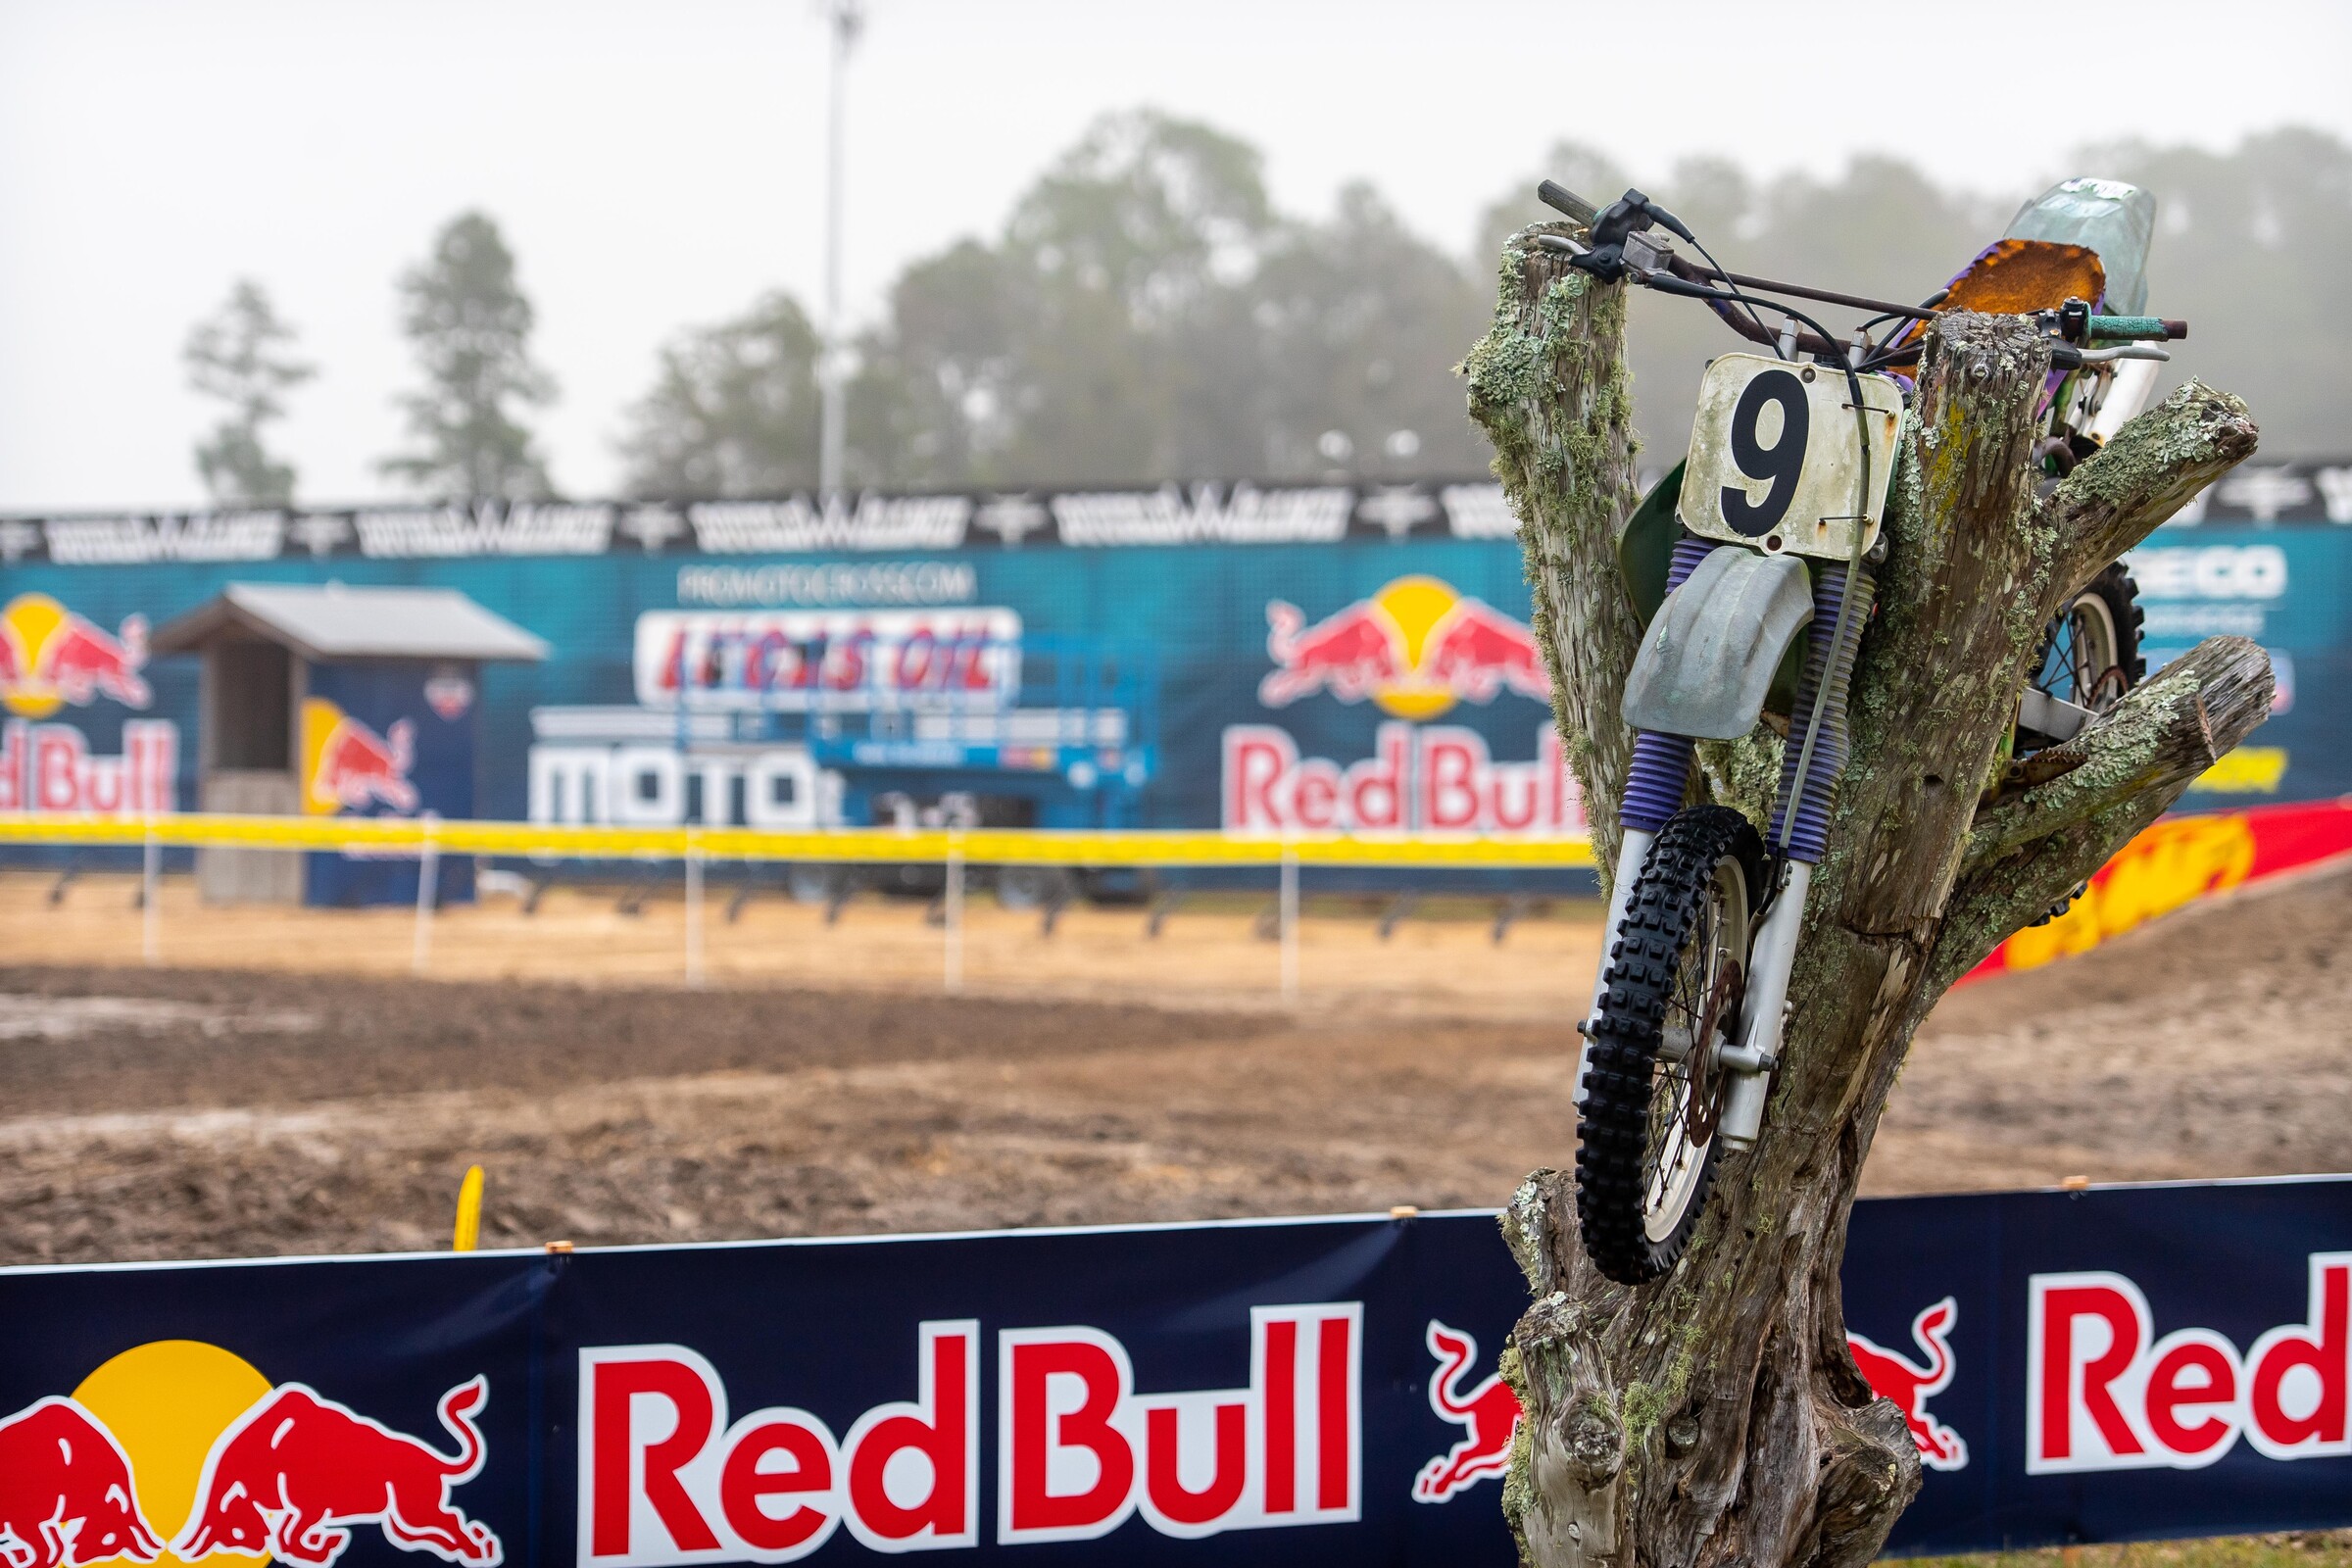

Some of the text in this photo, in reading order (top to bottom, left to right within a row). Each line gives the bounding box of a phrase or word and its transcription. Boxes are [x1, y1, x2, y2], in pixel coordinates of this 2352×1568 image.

[1721, 369, 1810, 538] 9
[37, 721, 177, 811] Bull
[1227, 725, 1586, 833] Red Bul
[584, 1307, 1358, 1564] Red Bull
[2031, 1255, 2352, 1470] Red
